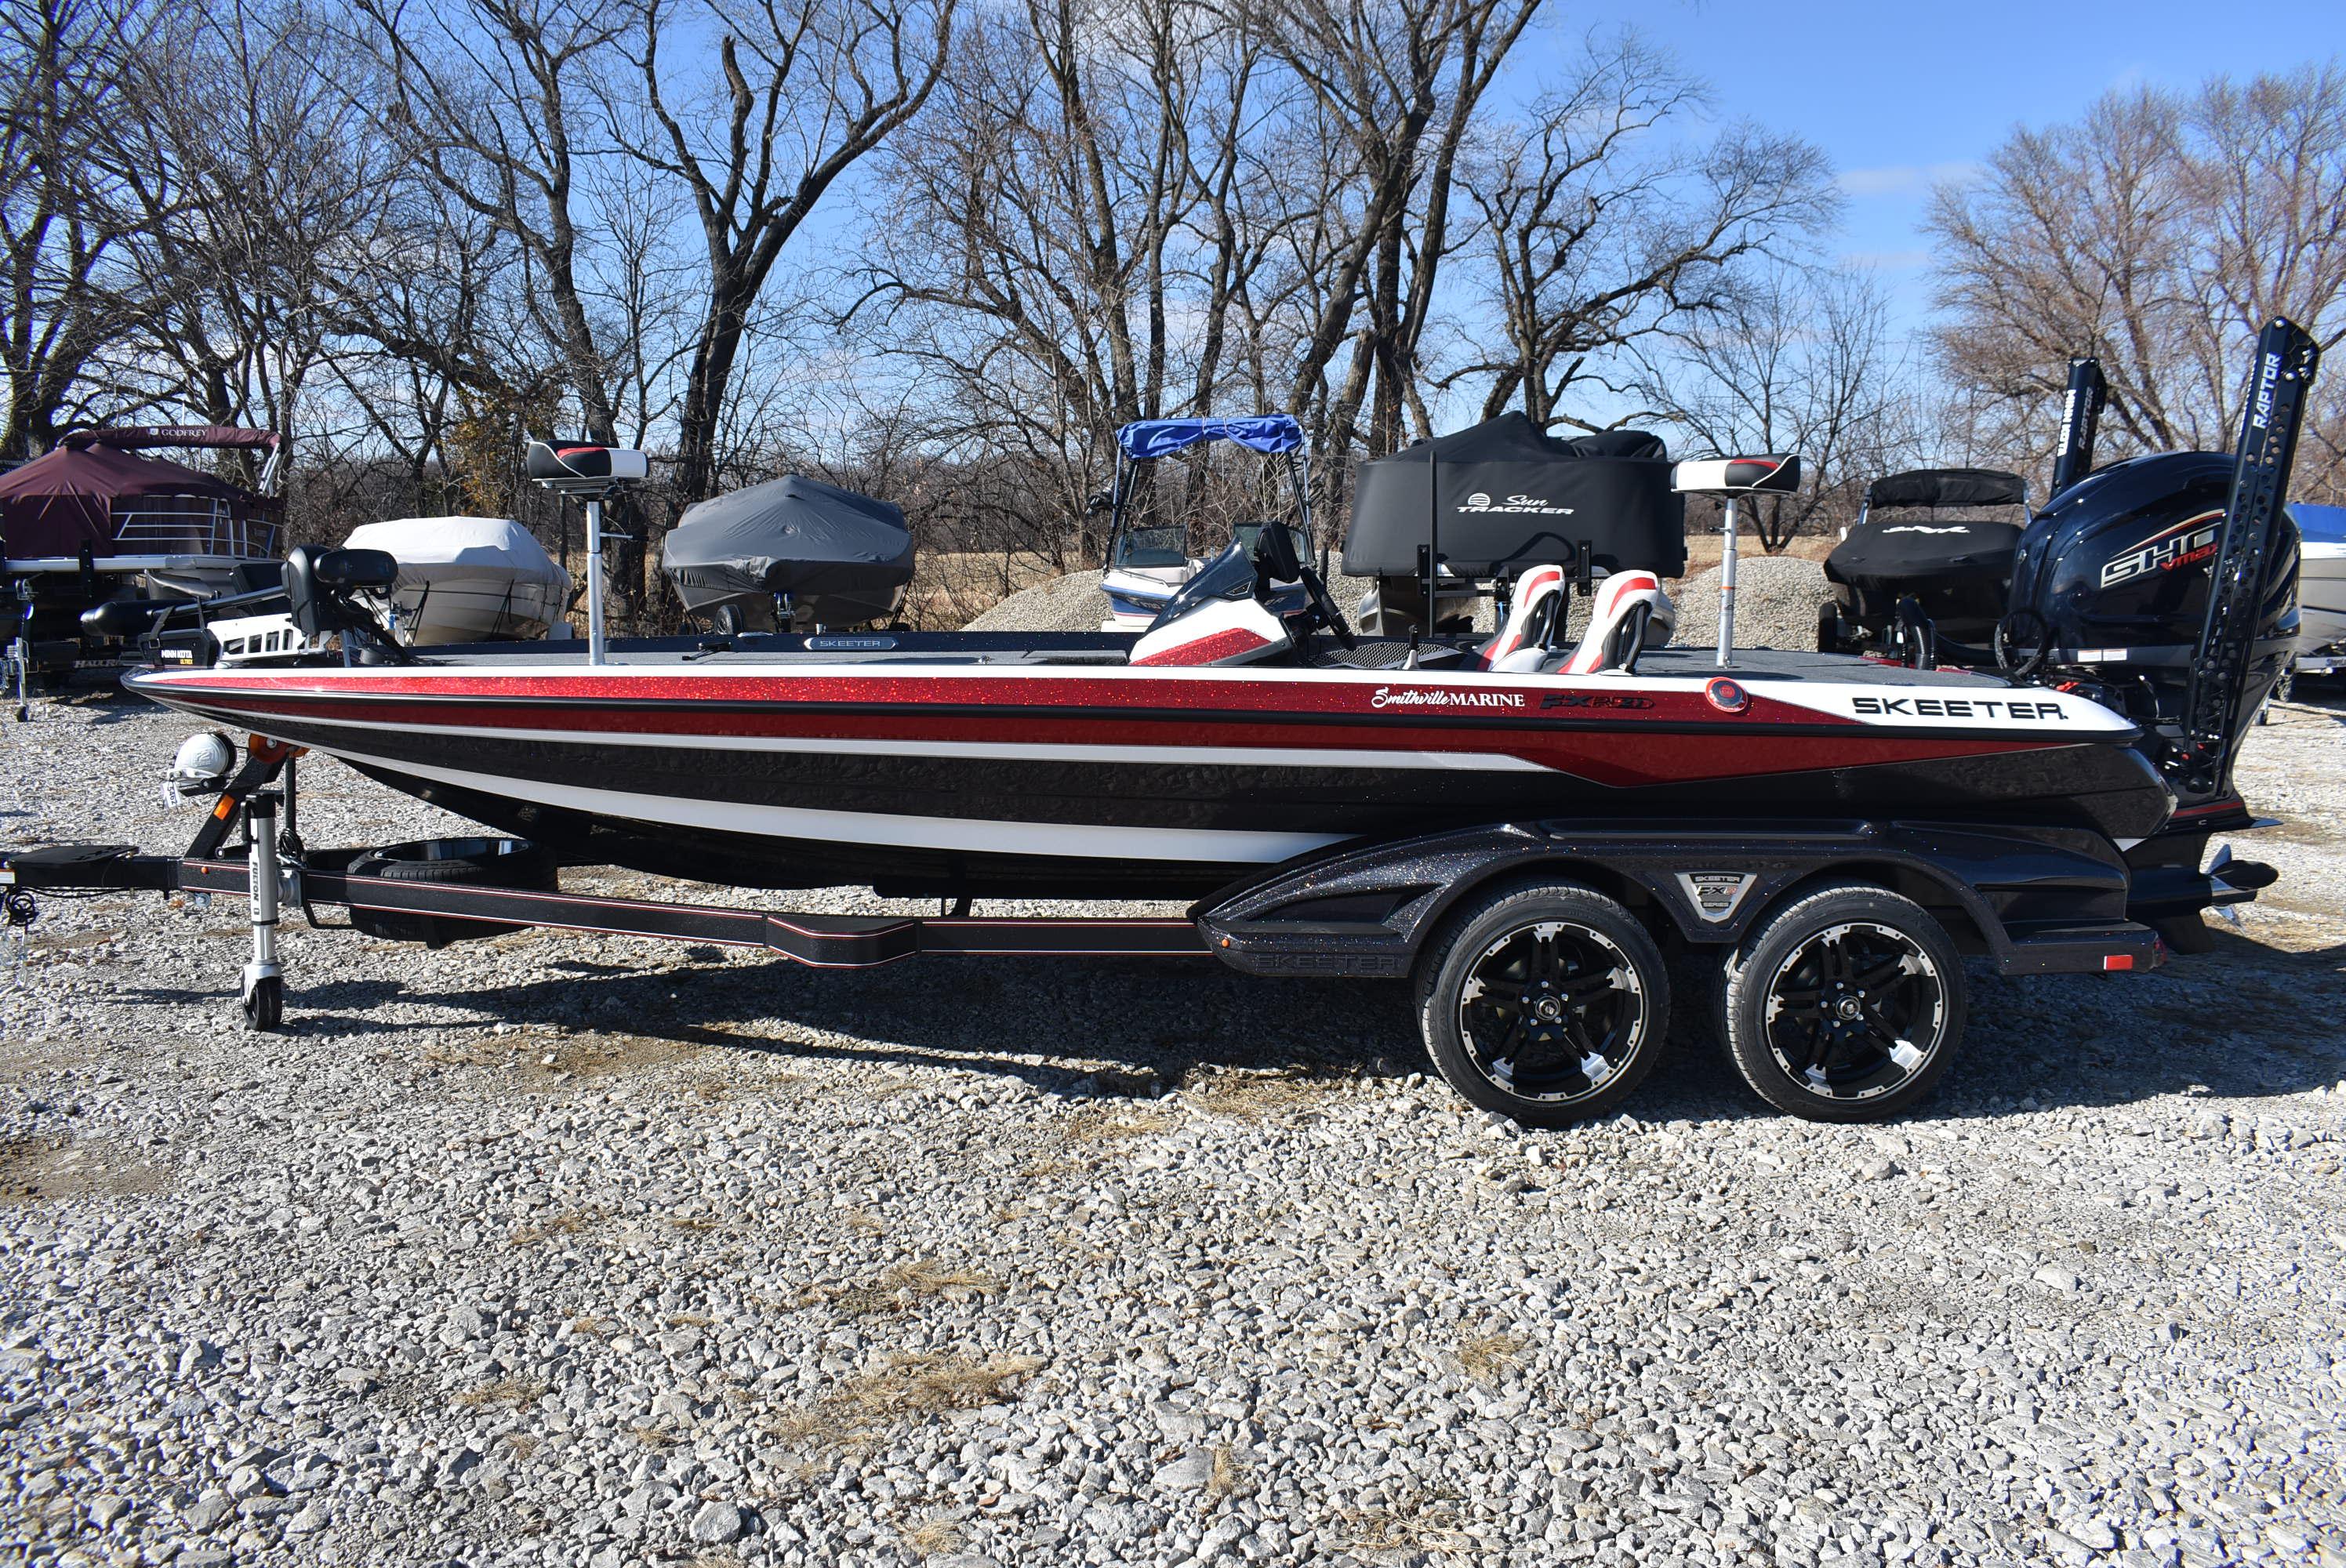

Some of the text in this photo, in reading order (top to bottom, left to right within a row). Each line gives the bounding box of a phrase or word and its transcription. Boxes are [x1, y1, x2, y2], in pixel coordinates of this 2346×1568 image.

[2253, 353, 2282, 430] RAPTOR
[161, 429, 207, 437] GODFREY
[1502, 495, 1549, 506] Sun
[1457, 506, 1574, 515] TRACKER
[1371, 687, 1525, 709] Smithville MARINE
[1852, 697, 2069, 720] SKEETER
[1255, 953, 1399, 970] SKEETER
